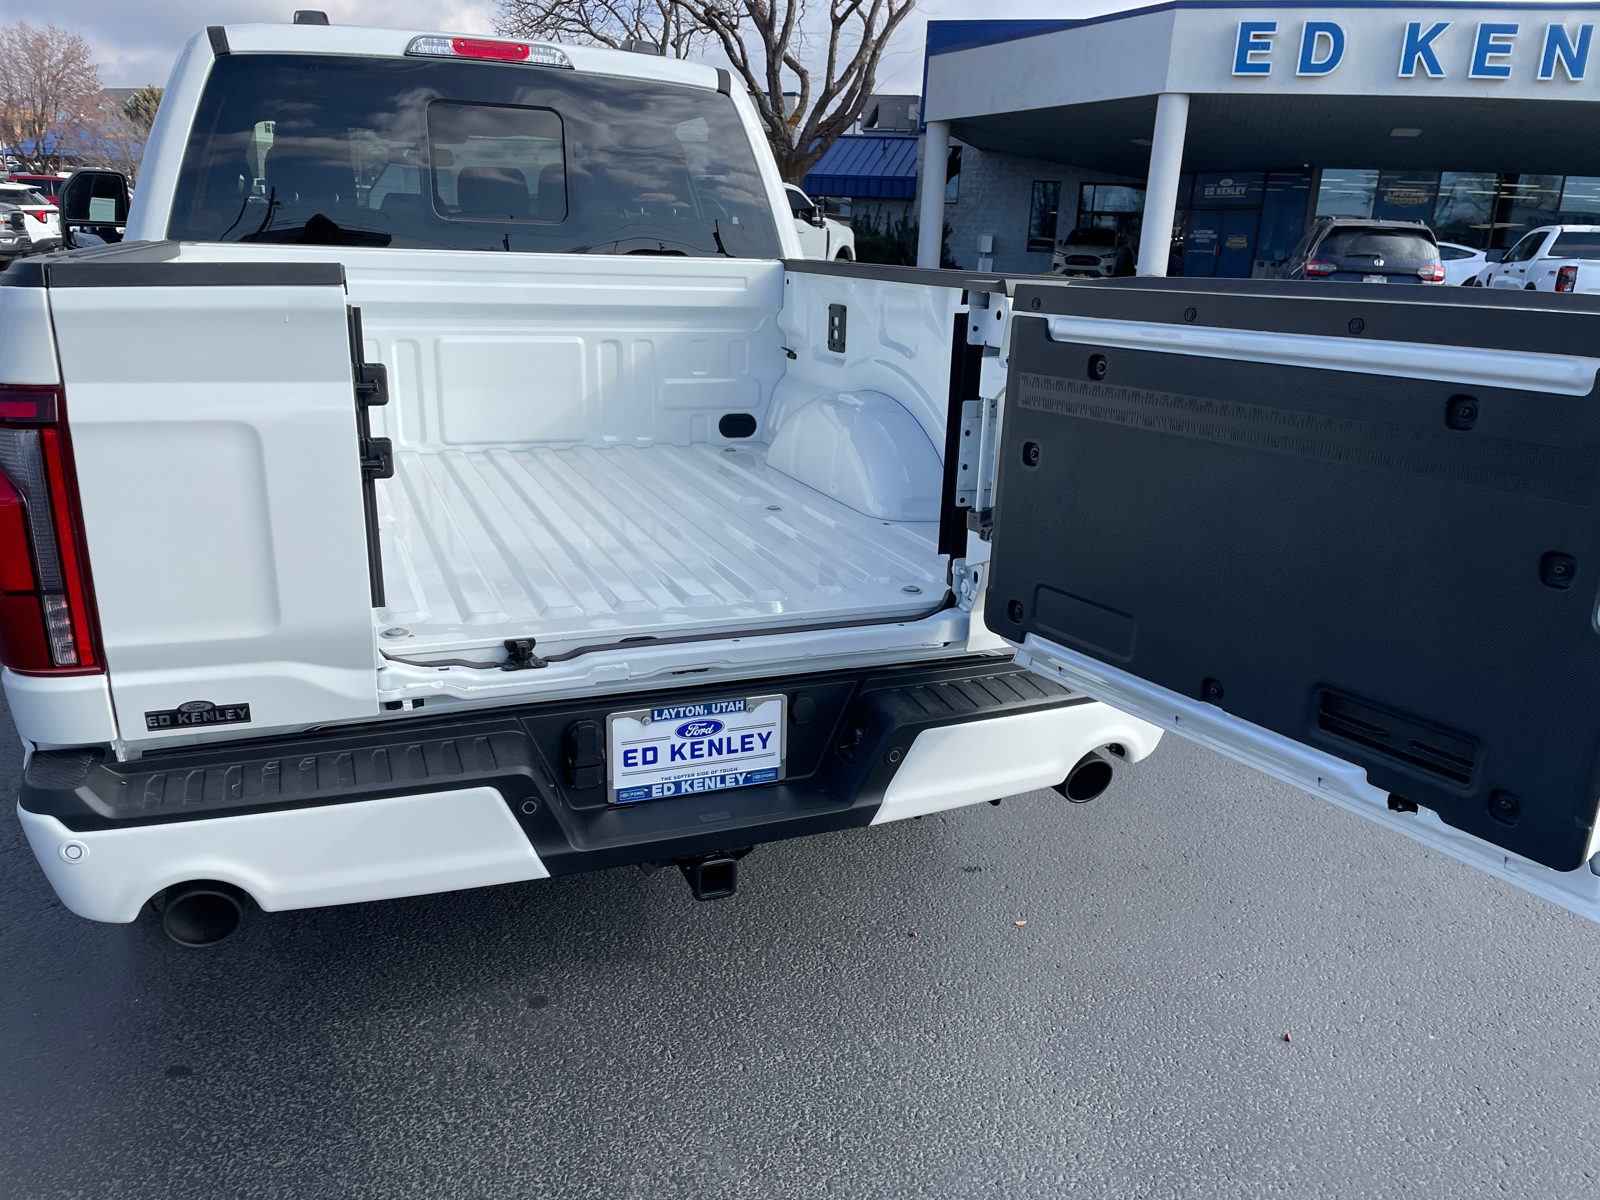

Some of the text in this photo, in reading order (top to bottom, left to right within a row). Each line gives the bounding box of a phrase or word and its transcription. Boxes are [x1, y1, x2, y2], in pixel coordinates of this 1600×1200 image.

[1231, 20, 1596, 81] ED KEN
[1204, 186, 1247, 196] ED KENLEY
[147, 708, 248, 726] ED KENLEY
[654, 701, 744, 720] LAYTON, UTAH
[685, 722, 714, 736] Ford
[623, 731, 773, 768] ED KENLEY
[673, 772, 695, 780] SOFTER
[762, 771, 776, 779] FORD
[651, 772, 747, 798] ED KENLEY
